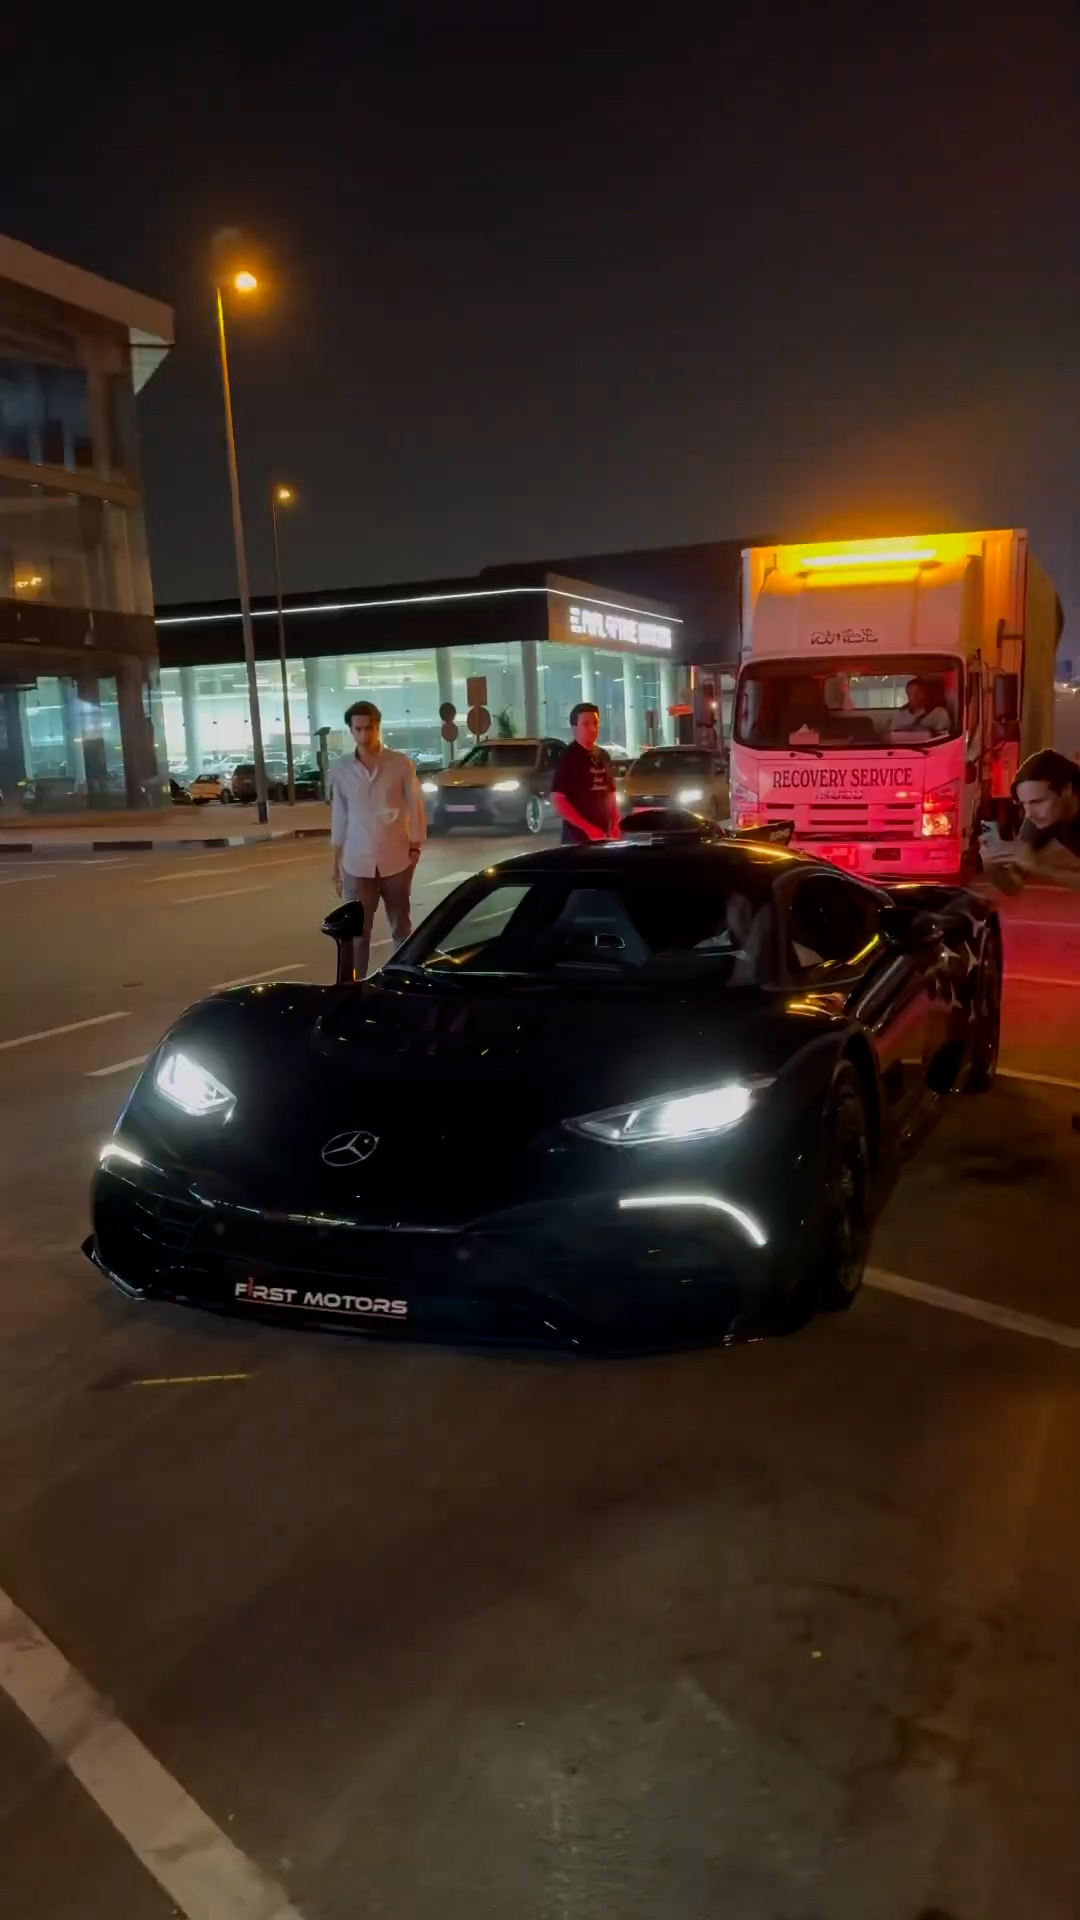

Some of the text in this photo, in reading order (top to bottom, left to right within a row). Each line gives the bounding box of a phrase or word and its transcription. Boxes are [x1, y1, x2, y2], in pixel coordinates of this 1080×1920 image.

[773, 767, 913, 788] RECOVERY SERVICE
[303, 1291, 408, 1315] MOTORS
